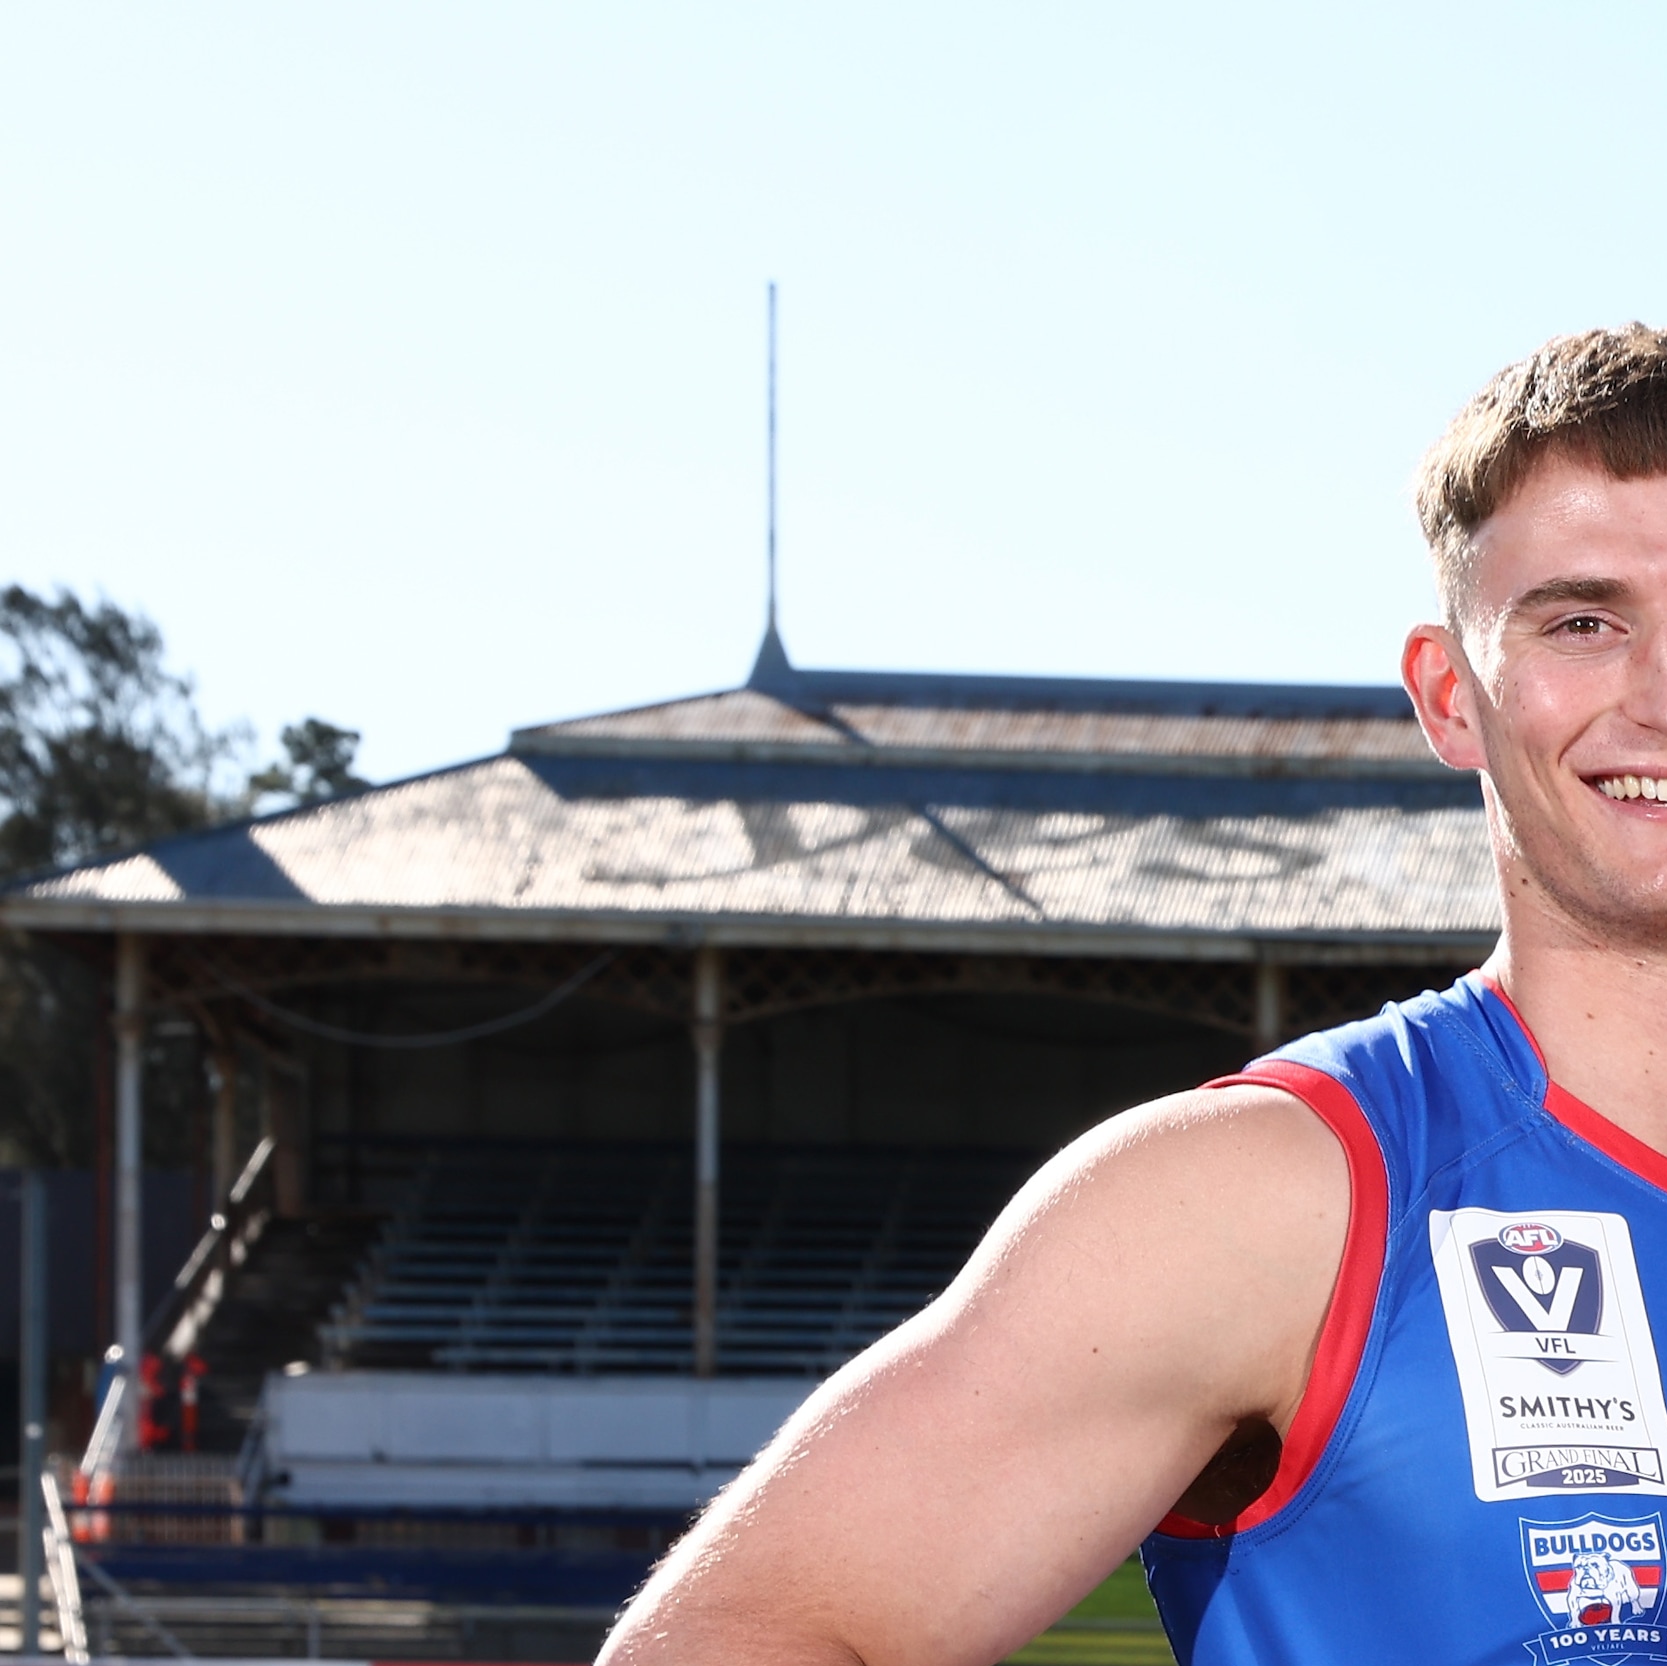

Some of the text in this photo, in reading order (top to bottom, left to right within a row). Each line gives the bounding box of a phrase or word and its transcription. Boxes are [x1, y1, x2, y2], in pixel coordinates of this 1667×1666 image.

[1504, 1228, 1559, 1248] AFL
[1534, 1337, 1577, 1355] VFL
[1499, 1395, 1636, 1422] SMITHY'S
[1520, 1422, 1625, 1432] CLASSIC AUSTRALIAN BEER
[1501, 1448, 1657, 1478] GRAND FINAL
[1561, 1468, 1607, 1485] 2025
[1533, 1532, 1656, 1557] BULLDOGS
[1550, 1628, 1661, 1649] 100 YEARS
